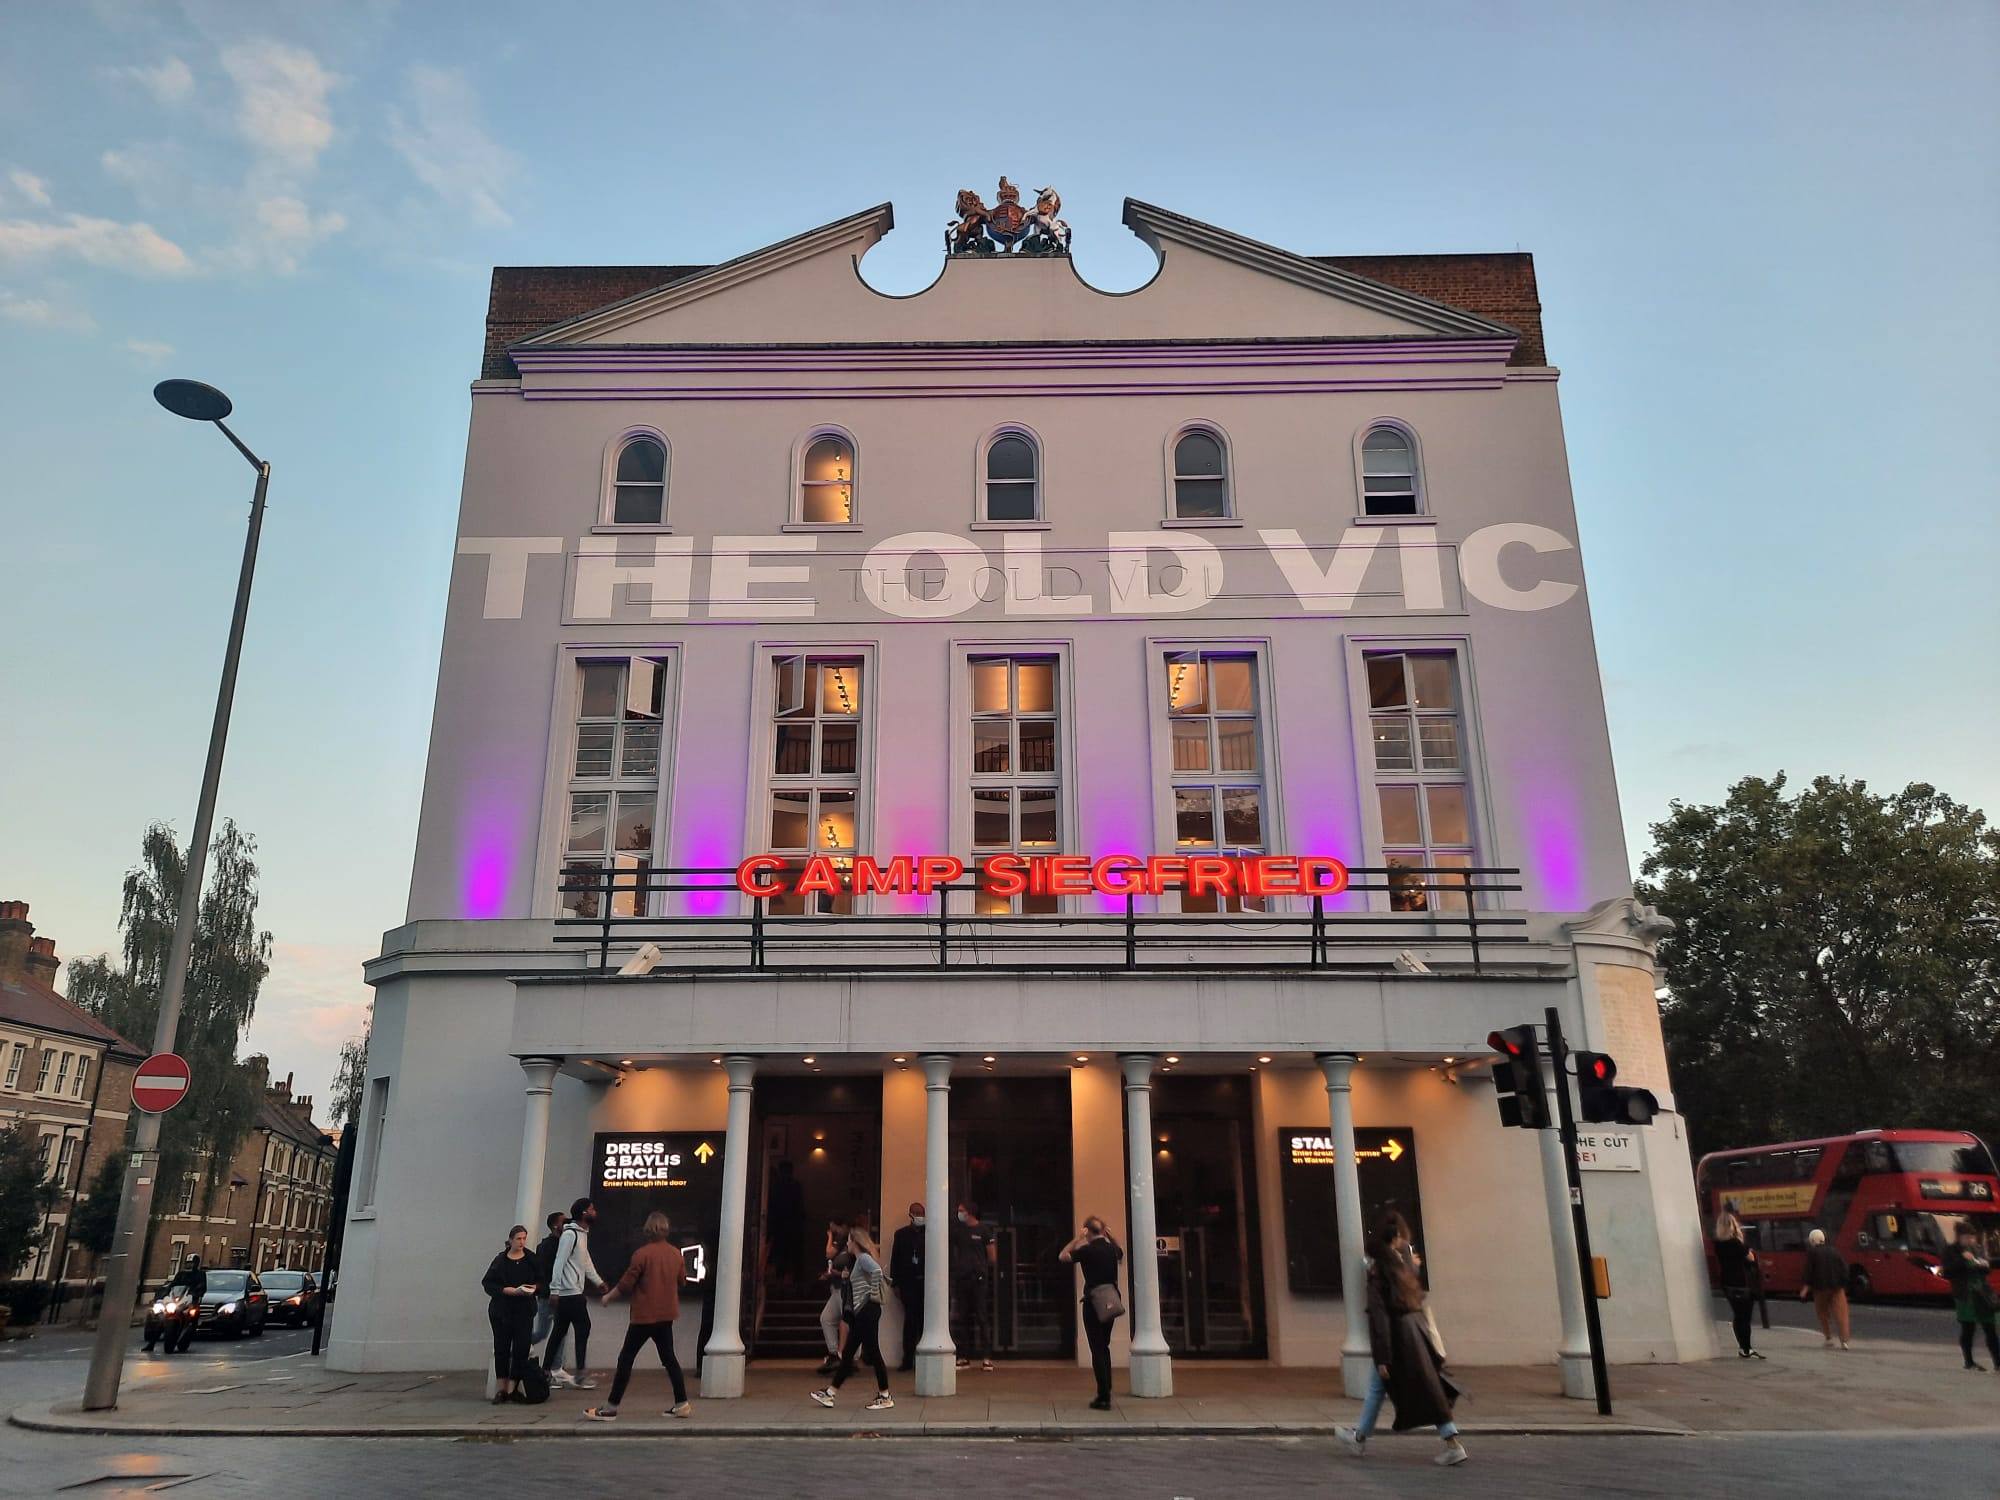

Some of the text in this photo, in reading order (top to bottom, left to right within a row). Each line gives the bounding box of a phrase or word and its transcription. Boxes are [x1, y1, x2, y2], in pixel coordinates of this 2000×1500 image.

[457, 522, 1579, 619] THE OLD VIC
[838, 559, 1191, 603] THE OLD VIC
[736, 854, 1349, 897] CAMP SIEGFRIED
[1291, 1137, 1334, 1149] STAL
[1578, 1137, 1629, 1148] HE CUT
[605, 1143, 665, 1155] DRESS
[604, 1154, 681, 1167] & BAYLIS
[603, 1167, 668, 1179] CIRCLE
[623, 1180, 654, 1188] through
